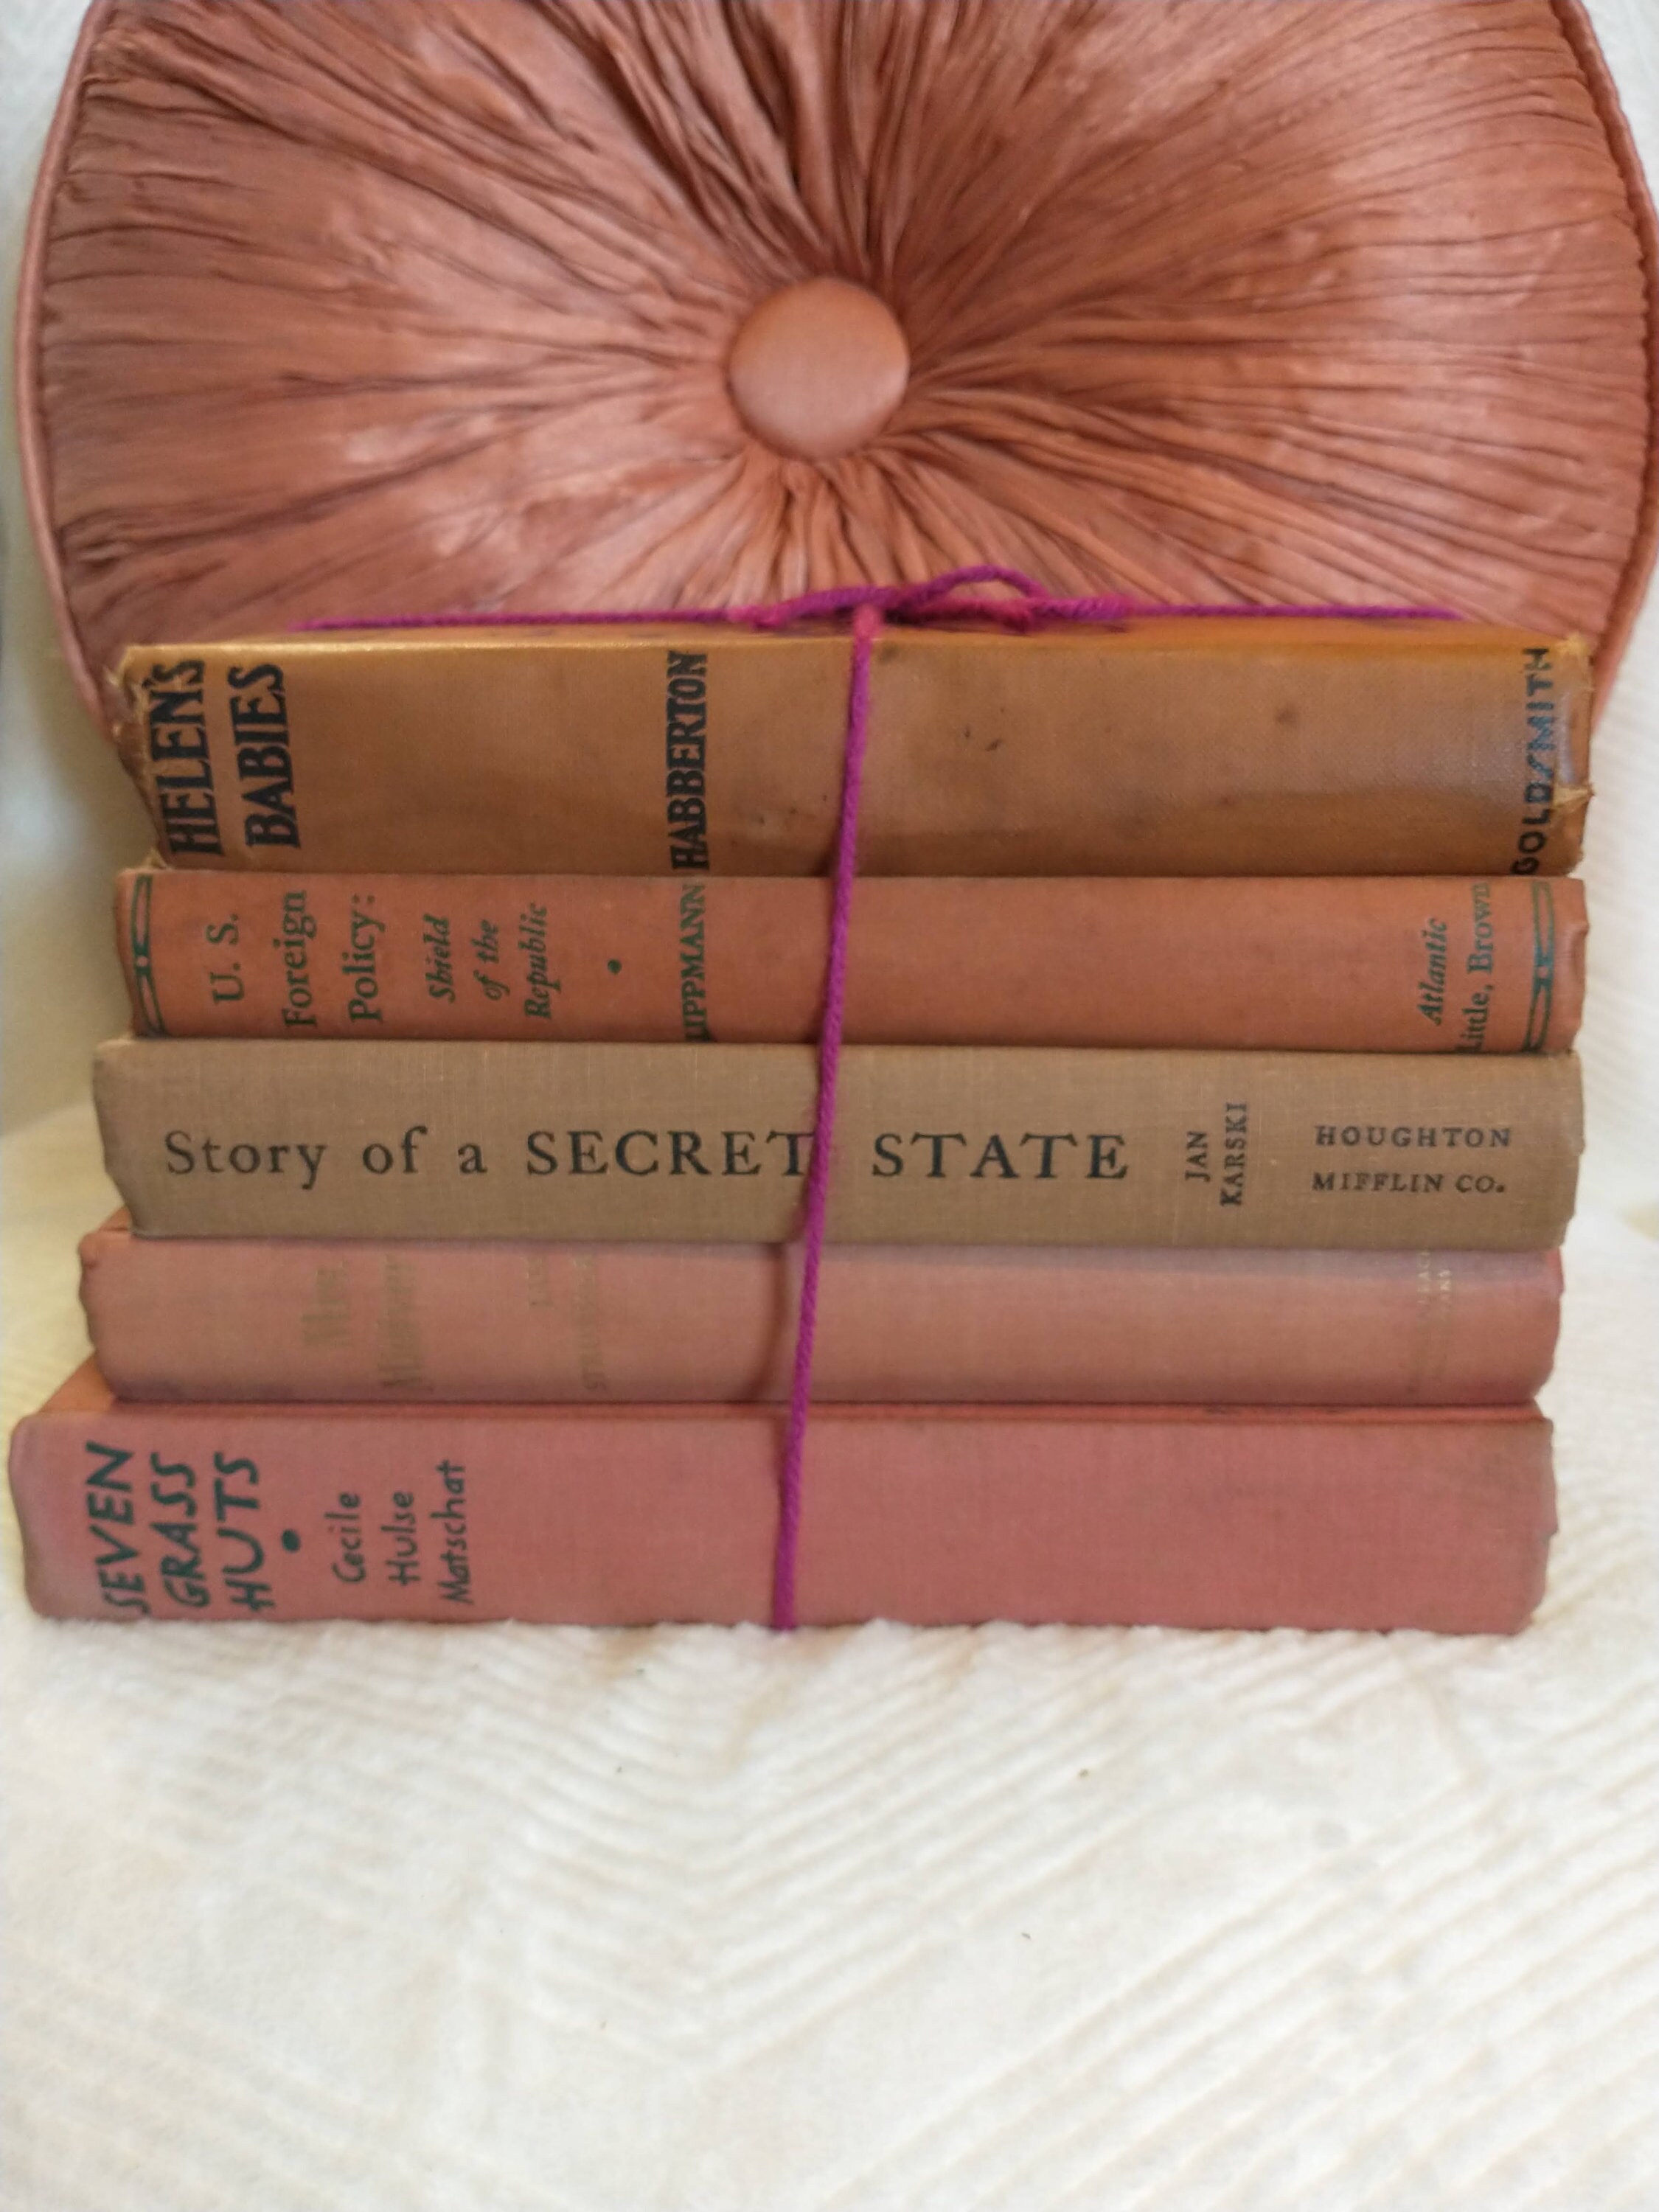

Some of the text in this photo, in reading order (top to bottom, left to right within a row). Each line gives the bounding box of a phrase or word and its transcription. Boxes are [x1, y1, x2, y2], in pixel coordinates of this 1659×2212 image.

[142, 660, 225, 856] HELEN'S
[227, 663, 302, 849] BABIES
[666, 650, 709, 870] HABBERTON
[1510, 647, 1555, 876] GOLDSMITH
[206, 913, 244, 1005] U. S.
[272, 889, 318, 1029] Foreign
[342, 893, 386, 1023] Policy:
[422, 913, 456, 1004] Shield
[470, 919, 510, 1001] of the
[518, 902, 561, 1019] Republic
[1416, 917, 1448, 1026] Atlantic
[1465, 882, 1495, 975] Brown
[164, 1125, 1129, 1190] Story of a SECRET STATE
[1184, 1130, 1211, 1183] JAN
[1220, 1102, 1248, 1208] KARSKI
[1311, 1172, 1506, 1194] MIFFLIN CO.
[1313, 1125, 1512, 1147] HOUGHTON
[84, 1440, 152, 1615] SEVEN
[150, 1451, 210, 1607] GRASS
[213, 1450, 275, 1613] HUTS
[323, 1492, 366, 1583] Cecile
[379, 1492, 422, 1586] Hulse
[429, 1459, 476, 1604] Matschat
